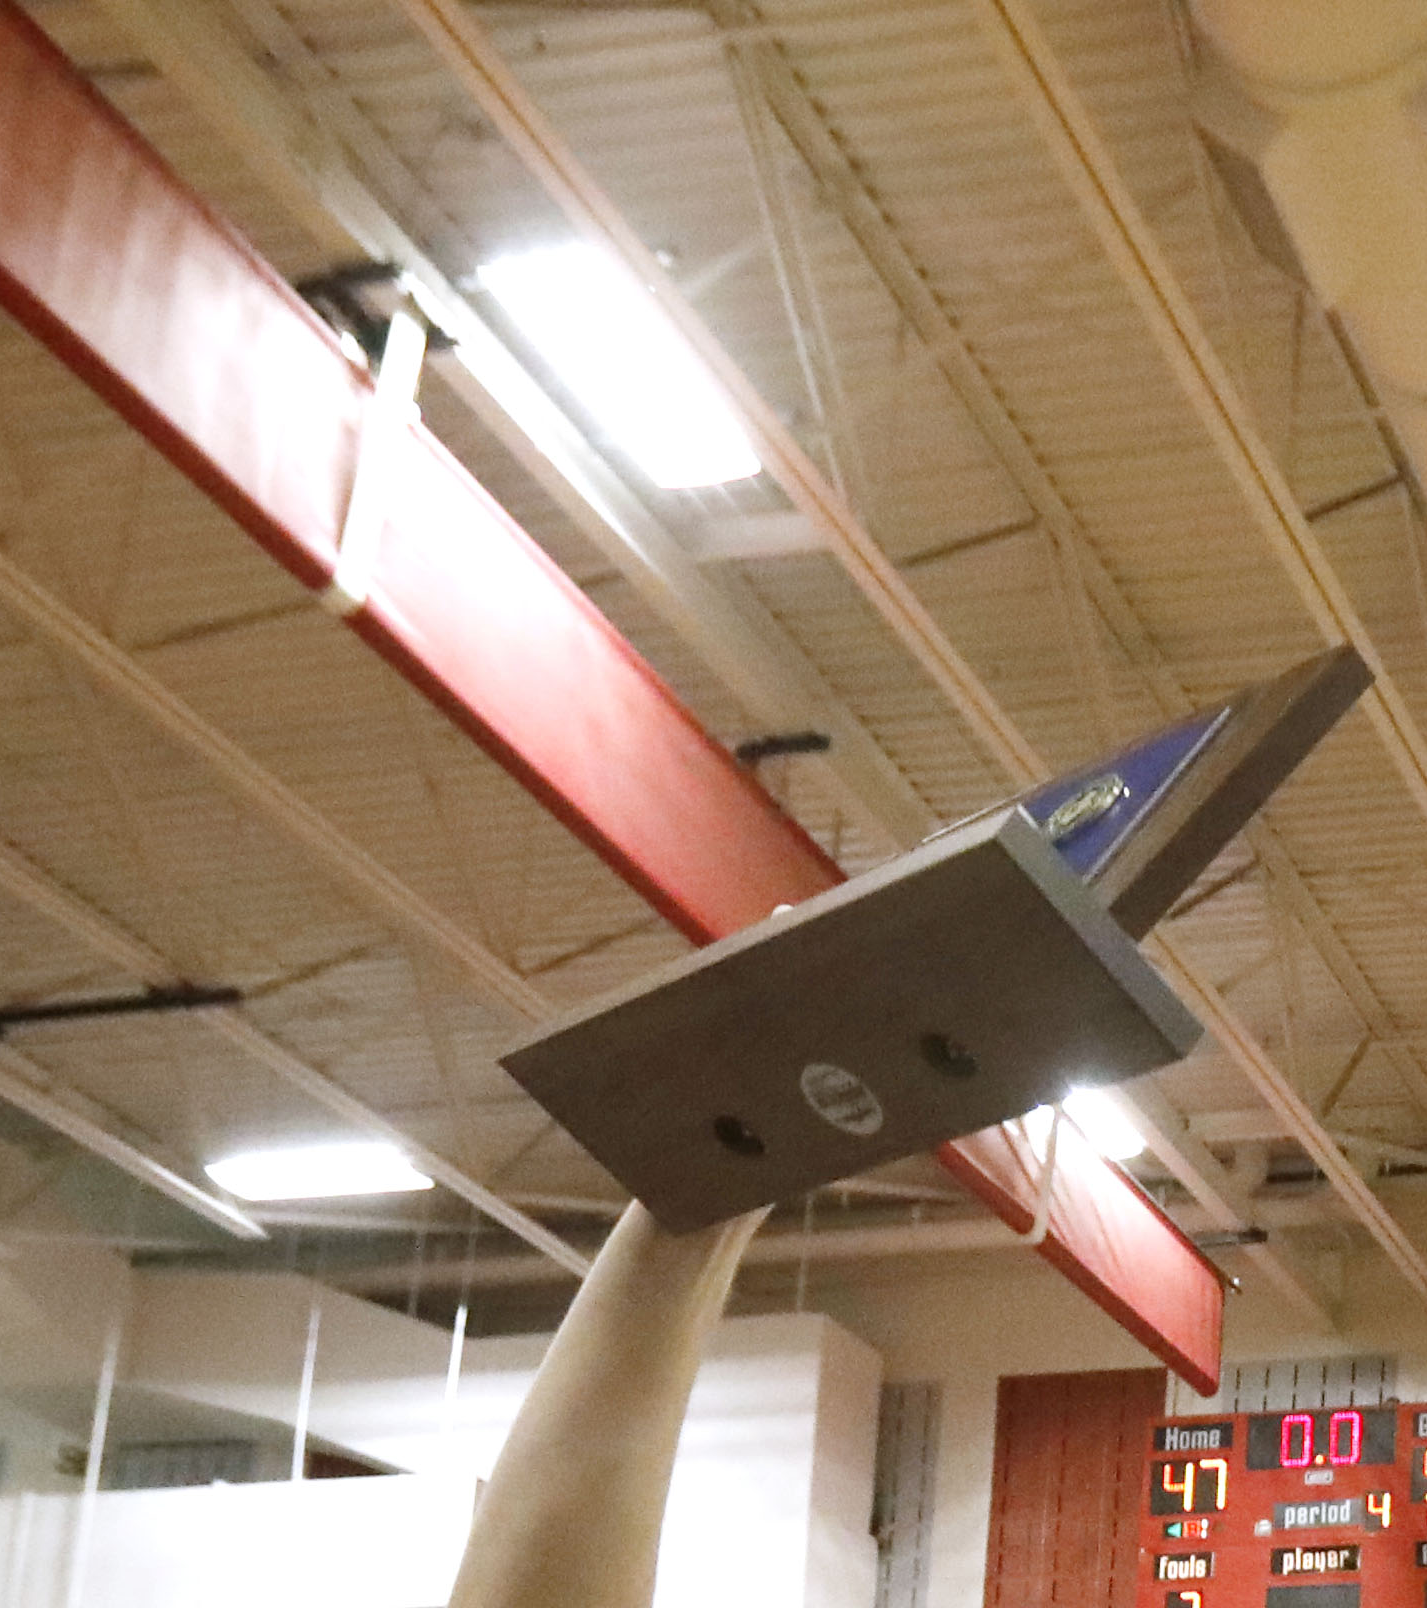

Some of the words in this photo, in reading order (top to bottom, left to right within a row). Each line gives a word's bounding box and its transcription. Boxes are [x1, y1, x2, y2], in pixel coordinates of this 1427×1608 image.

[1164, 1426, 1221, 1451] Home
[1280, 1411, 1363, 1467] 0.0
[1162, 1458, 1229, 1512] 47
[1283, 1502, 1351, 1529] period
[1366, 1491, 1392, 1529] 4
[1158, 1554, 1207, 1580] fouls
[1281, 1547, 1351, 1576] player
